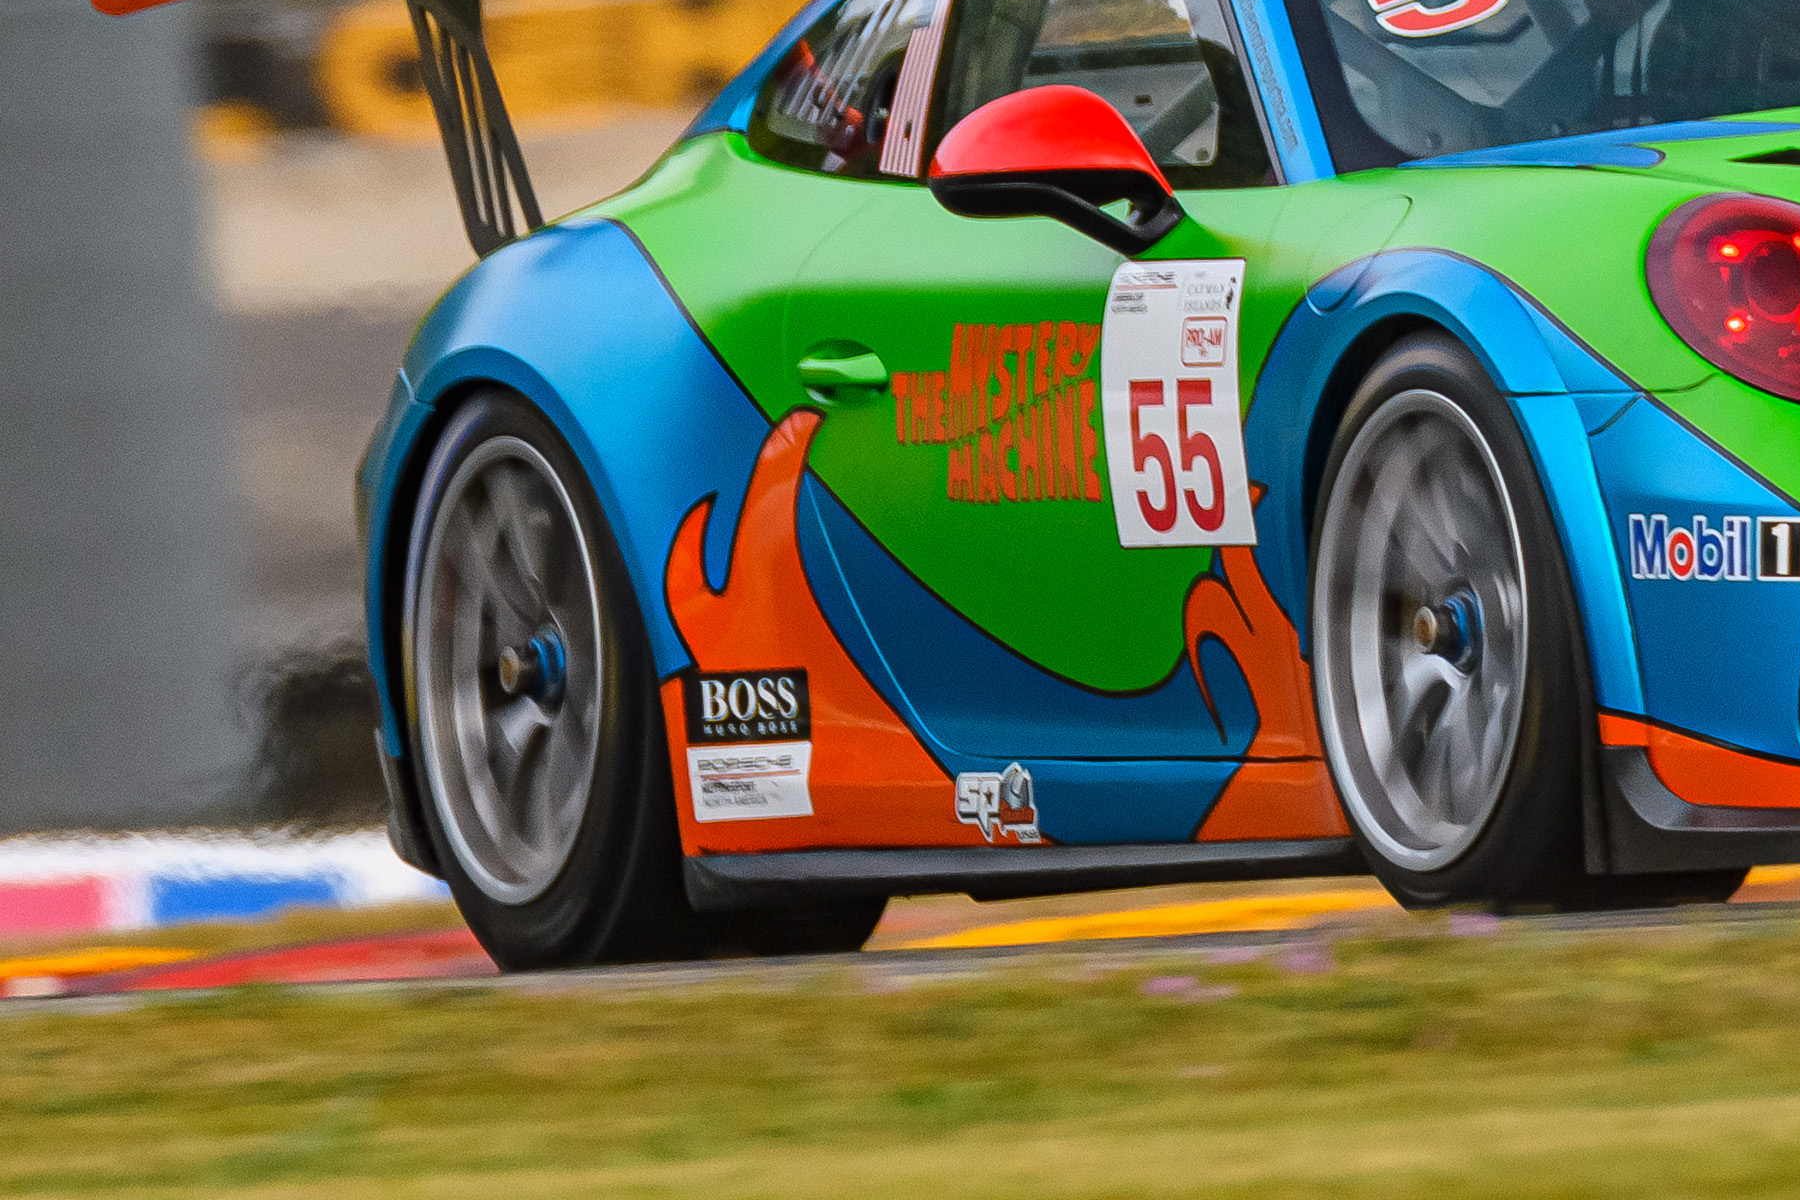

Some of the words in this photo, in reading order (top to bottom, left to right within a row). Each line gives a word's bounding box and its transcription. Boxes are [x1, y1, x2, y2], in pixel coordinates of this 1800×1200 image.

[892, 371, 949, 446] THE
[950, 320, 1102, 441] MYSTERY
[947, 378, 1103, 504] MACHINE
[1129, 378, 1226, 533] 55
[1629, 515, 1751, 580] Mobil
[1768, 523, 1790, 575] 1
[699, 677, 799, 722] BOSS
